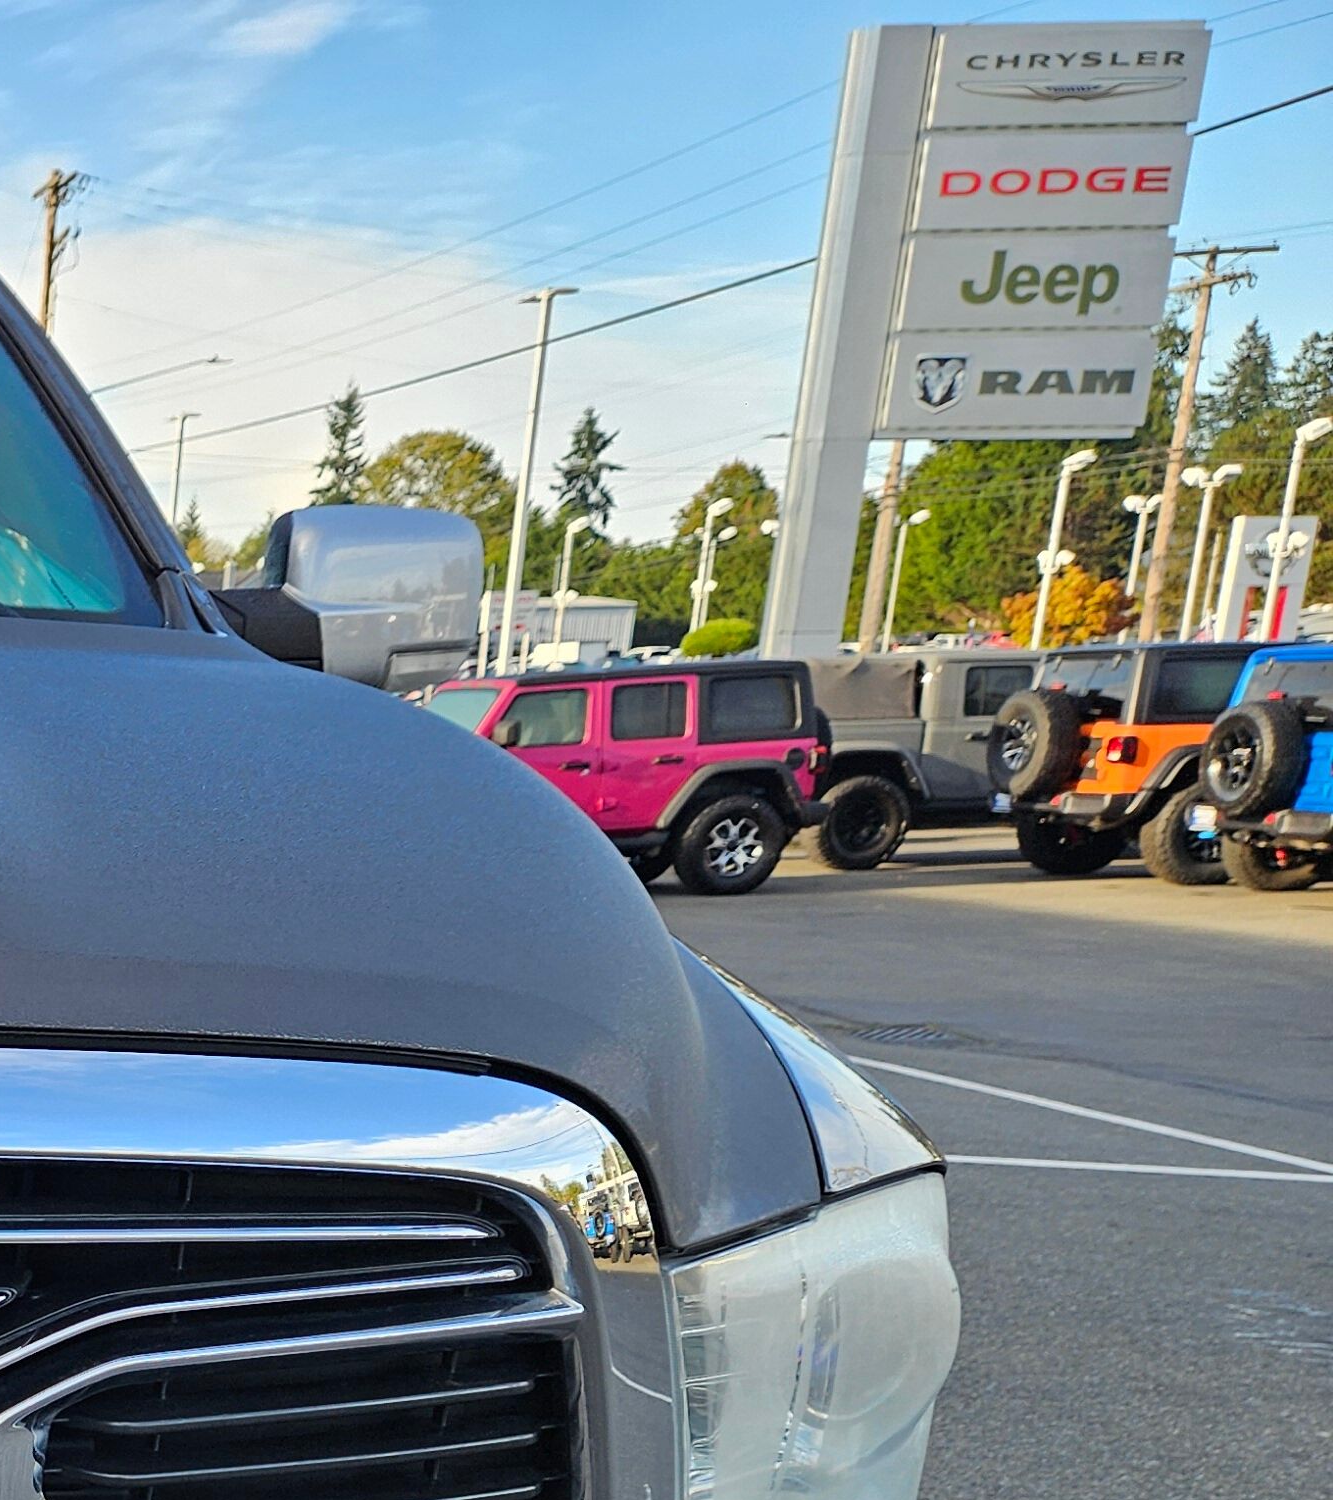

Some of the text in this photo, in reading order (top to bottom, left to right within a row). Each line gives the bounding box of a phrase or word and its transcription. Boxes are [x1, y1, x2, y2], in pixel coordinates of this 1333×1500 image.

[965, 50, 1186, 71] CHRYSLER
[939, 166, 1172, 197] DODGE
[960, 250, 1120, 316] Jeep
[978, 369, 1135, 395] RAM
